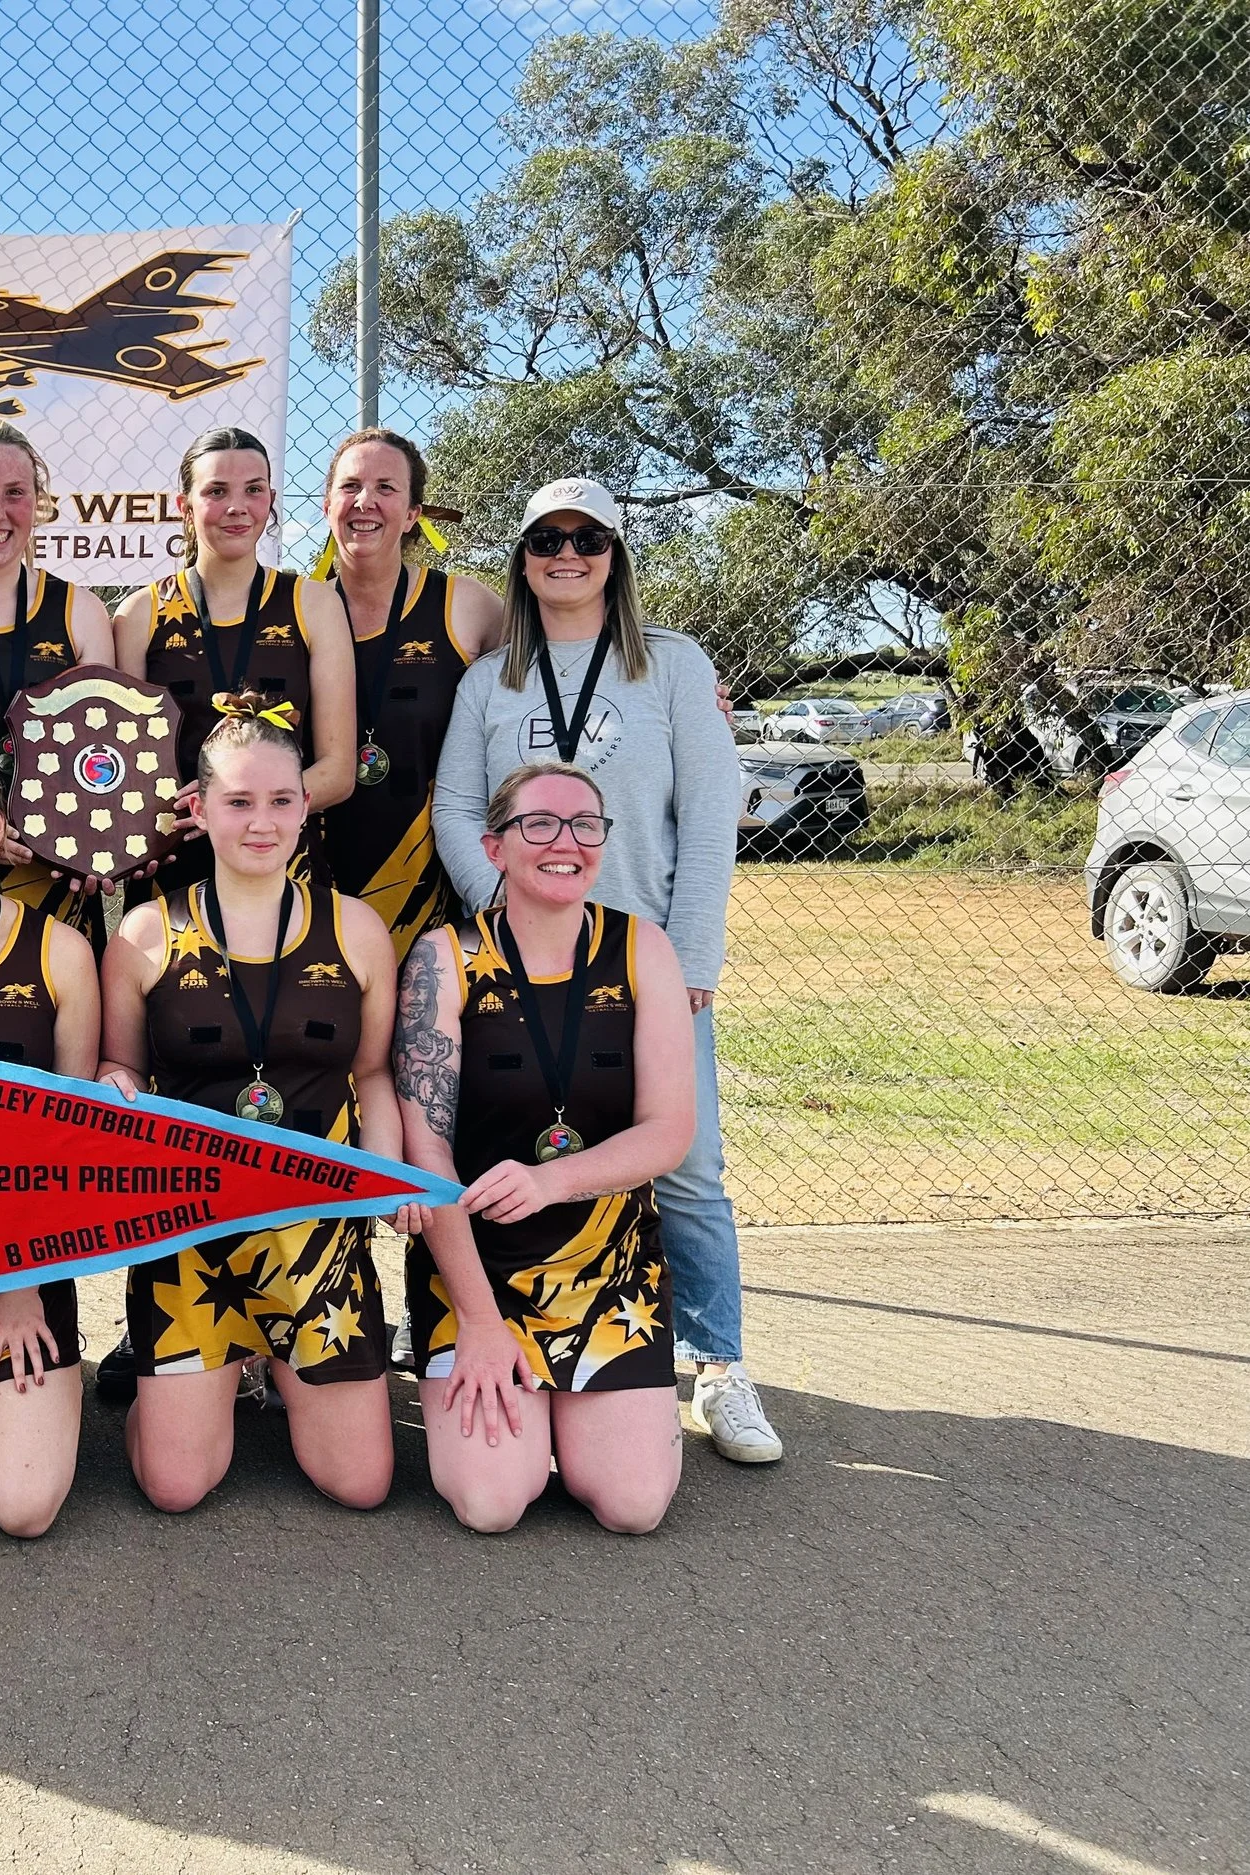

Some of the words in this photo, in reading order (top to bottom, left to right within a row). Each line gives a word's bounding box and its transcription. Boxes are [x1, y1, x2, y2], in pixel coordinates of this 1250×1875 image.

[70, 493, 183, 523] WEL
[34, 534, 154, 559] ETBALL
[591, 737, 622, 772] MBERS
[478, 1002, 504, 1010] PDR
[41, 1095, 156, 1144] FOOTBALL
[164, 1124, 262, 1170] NETBALL
[269, 1150, 360, 1194] LEAGUE
[79, 1165, 221, 1194] PREMIERS
[4, 1242, 23, 1267] B
[28, 1224, 109, 1263] GRADE
[113, 1199, 217, 1245] NETBALL
